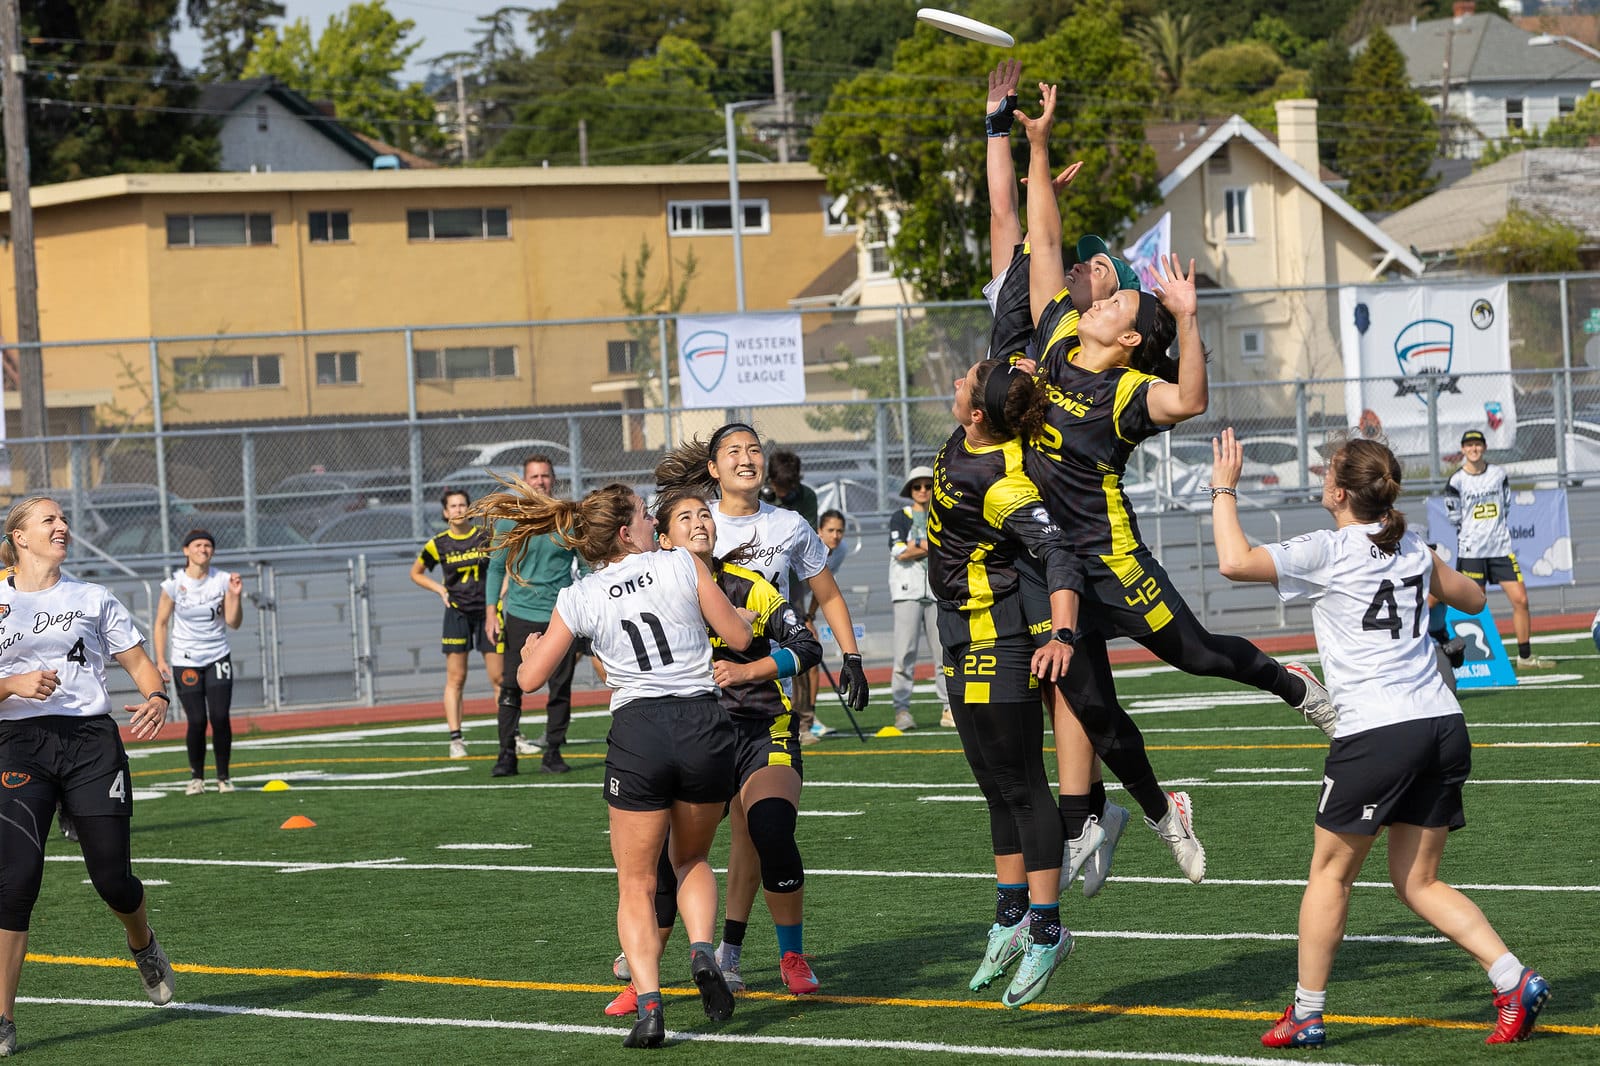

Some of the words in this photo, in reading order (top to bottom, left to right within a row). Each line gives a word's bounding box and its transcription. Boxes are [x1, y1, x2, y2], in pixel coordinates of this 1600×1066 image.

[735, 337, 797, 350] WESTERN
[736, 353, 797, 367] ULTIMATE
[737, 371, 786, 384] LEAGUE
[1473, 503, 1498, 520] 23
[457, 564, 479, 584] 71
[608, 571, 653, 600] ONES
[1124, 576, 1162, 607] 42
[1362, 574, 1424, 640] 47
[33, 610, 86, 634] Diego
[67, 637, 87, 667] 4
[621, 612, 674, 672] 11
[214, 661, 232, 680] 19
[963, 654, 997, 676] 22
[109, 769, 126, 804] 4
